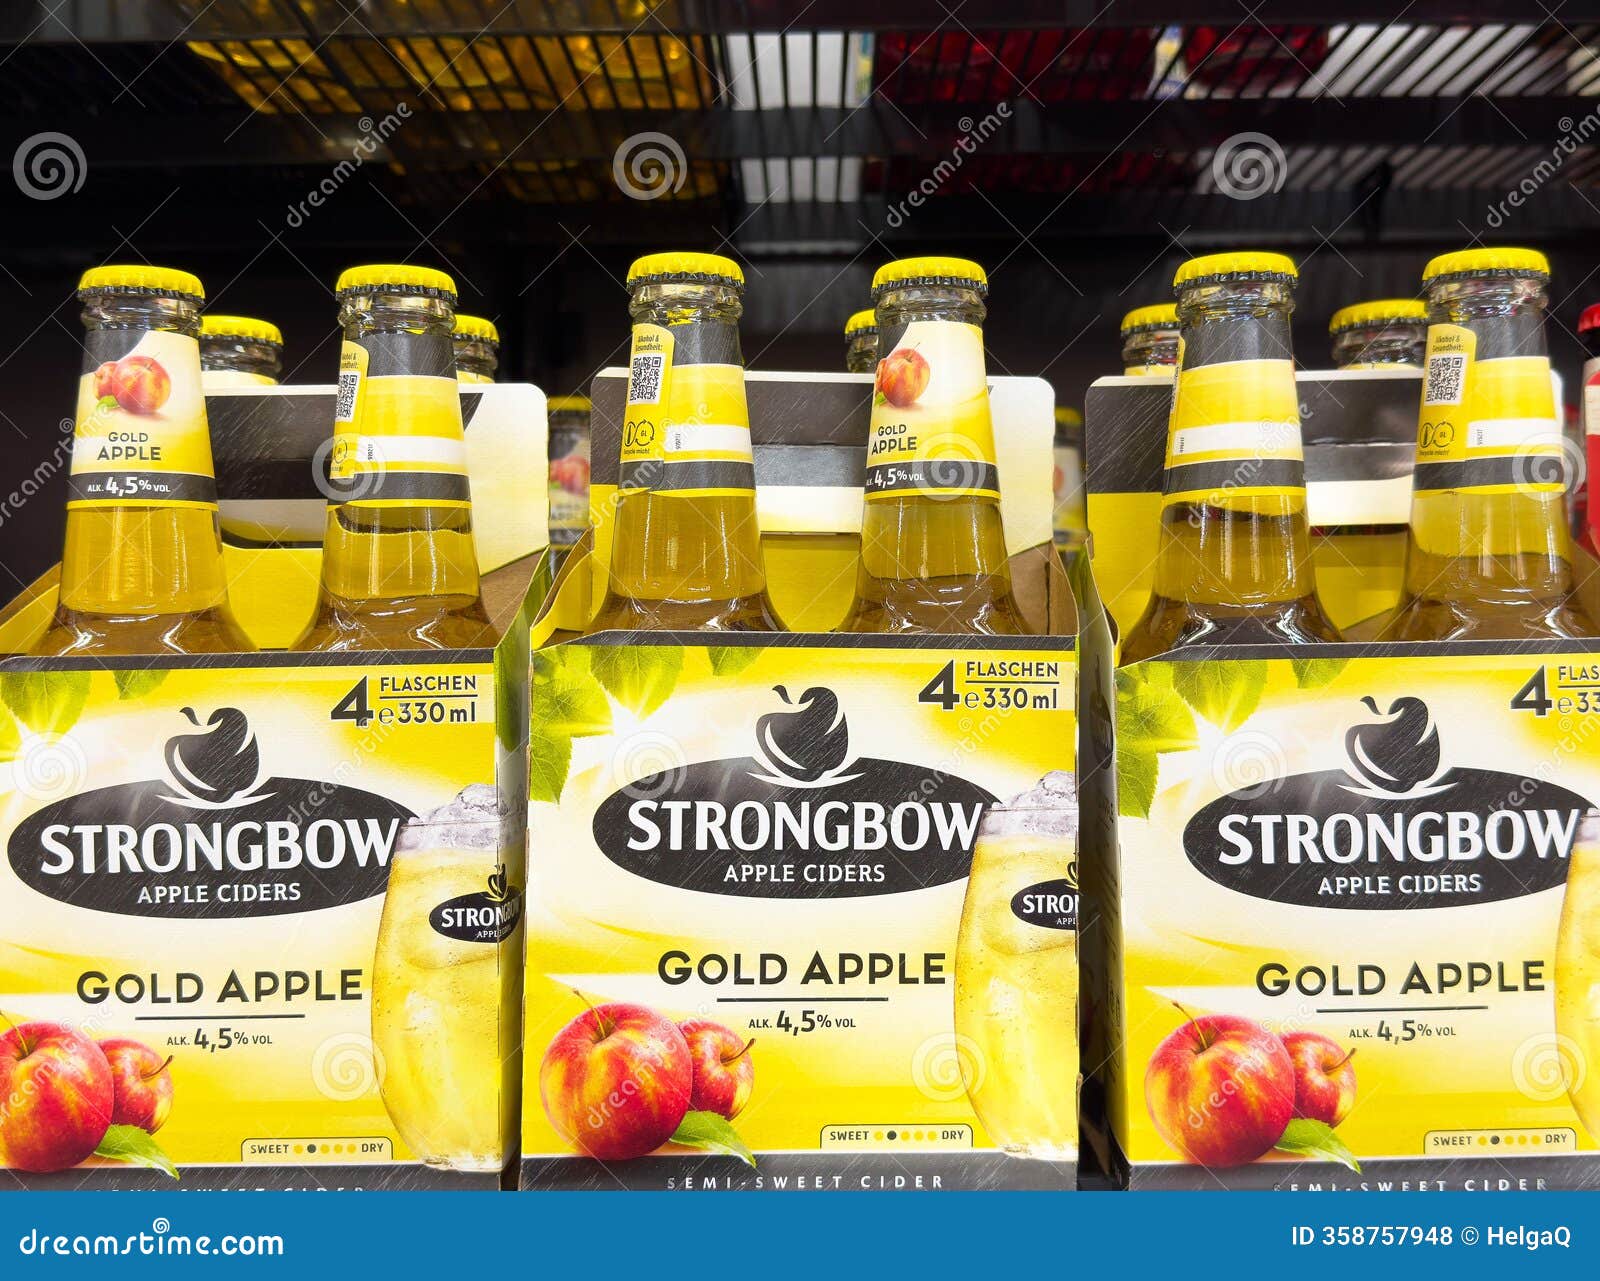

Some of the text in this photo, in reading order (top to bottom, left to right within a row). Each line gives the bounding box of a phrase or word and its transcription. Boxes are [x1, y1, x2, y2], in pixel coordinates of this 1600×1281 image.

[108, 432, 149, 443] GOLD
[877, 424, 907, 436] GOLD
[97, 446, 161, 461] APPLE
[871, 436, 918, 455] APPLE
[105, 476, 152, 497] 4,5%
[154, 483, 171, 493] VOL
[874, 467, 908, 488] 4,5%
[909, 473, 925, 481] VOL
[966, 661, 1059, 677] FLASCHEN
[380, 675, 476, 692] FLASCHEN
[918, 659, 960, 710] 4
[1510, 664, 1553, 717] 4
[330, 675, 374, 727] 4
[626, 800, 985, 852] STRONGBOW
[1218, 808, 1581, 865] STRONGBOW
[40, 816, 402, 875] STRONGBOW
[723, 864, 886, 883] APPLE CIDERS
[138, 882, 301, 905] APPLE CIDERS
[1318, 874, 1481, 896] APPLE CIDERS
[657, 949, 946, 986] GOLD APPLE
[76, 968, 363, 1004] GOLD APPLE
[1255, 960, 1546, 997] GOLD APPLE
[748, 1010, 857, 1036] ALK. 4,5% VOL
[1349, 1019, 1457, 1044] ALK. 4,5% VOL
[167, 1027, 273, 1052] ALK. 4,5% VOL
[829, 1130, 869, 1142] SWEET
[941, 1130, 964, 1141] DRY
[1432, 1135, 1472, 1147] SWEET
[1545, 1133, 1568, 1145] DRY
[250, 1144, 290, 1155] SWEET
[361, 1142, 384, 1153] DRY
[667, 1175, 943, 1190] SEMI-SWEET CIDER
[1464, 1178, 1547, 1191] CIDER
